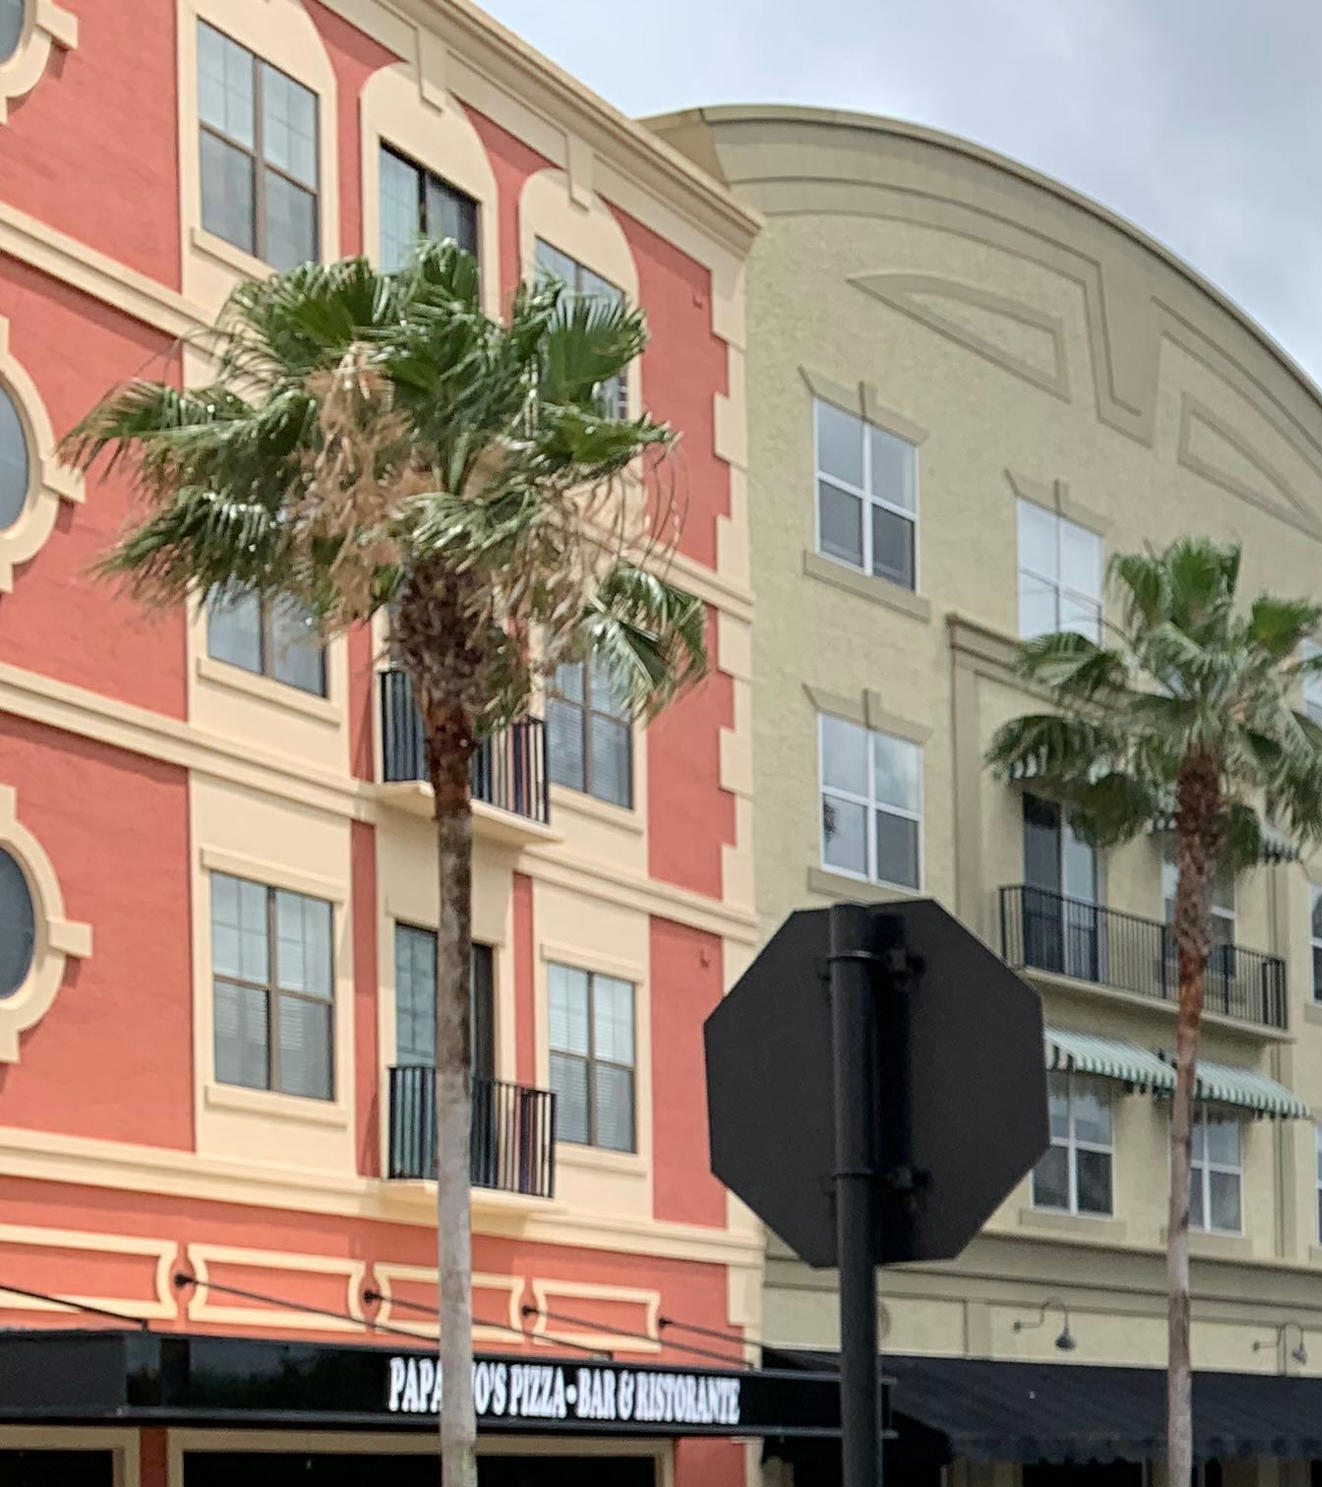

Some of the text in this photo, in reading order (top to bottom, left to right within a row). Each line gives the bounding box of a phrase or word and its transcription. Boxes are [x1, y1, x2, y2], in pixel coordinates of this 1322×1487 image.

[472, 1360, 507, 1416] O'S
[509, 1364, 566, 1418] PIZZA
[576, 1367, 616, 1420] BAR
[617, 1370, 635, 1421] &
[634, 1371, 741, 1425] RISTORANTE
